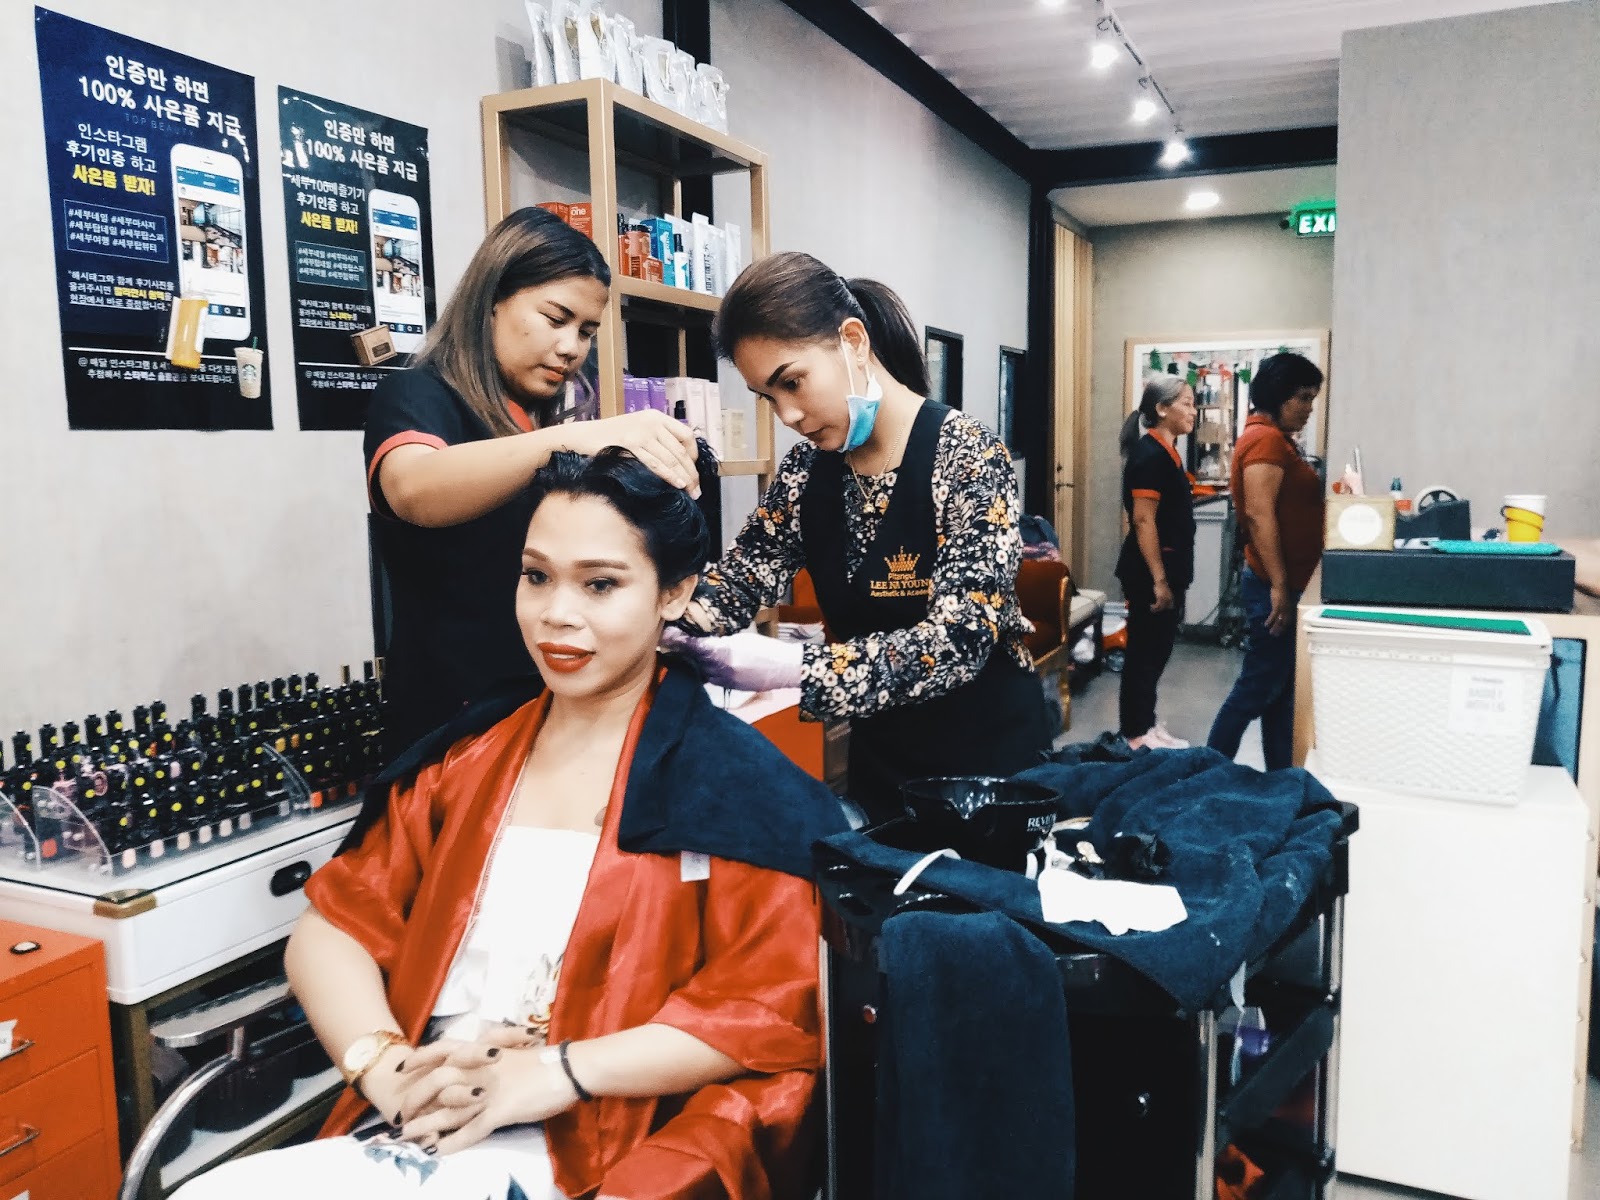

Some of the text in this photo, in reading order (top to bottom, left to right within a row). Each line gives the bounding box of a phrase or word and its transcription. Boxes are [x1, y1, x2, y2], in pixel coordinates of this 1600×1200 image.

[105, 54, 210, 104] 인증만 하면
[78, 76, 242, 137] 100% 사은품 지급
[77, 123, 149, 154] 인스타그램
[323, 118, 396, 155] 인증만 하면
[65, 139, 158, 174] 후기인증 하고
[306, 138, 346, 164] 100%
[350, 149, 391, 175] 사은품
[392, 159, 419, 183] 지급
[72, 163, 156, 197] 사은품 받자!
[68, 208, 109, 224] #세부네일
[296, 191, 360, 216] 후기인증 하고
[300, 210, 332, 231] 사은품
[335, 216, 359, 235] 받자!
[1299, 214, 1336, 233] EXI
[870, 580, 888, 589] LEE
[901, 579, 929, 588] YOUN
